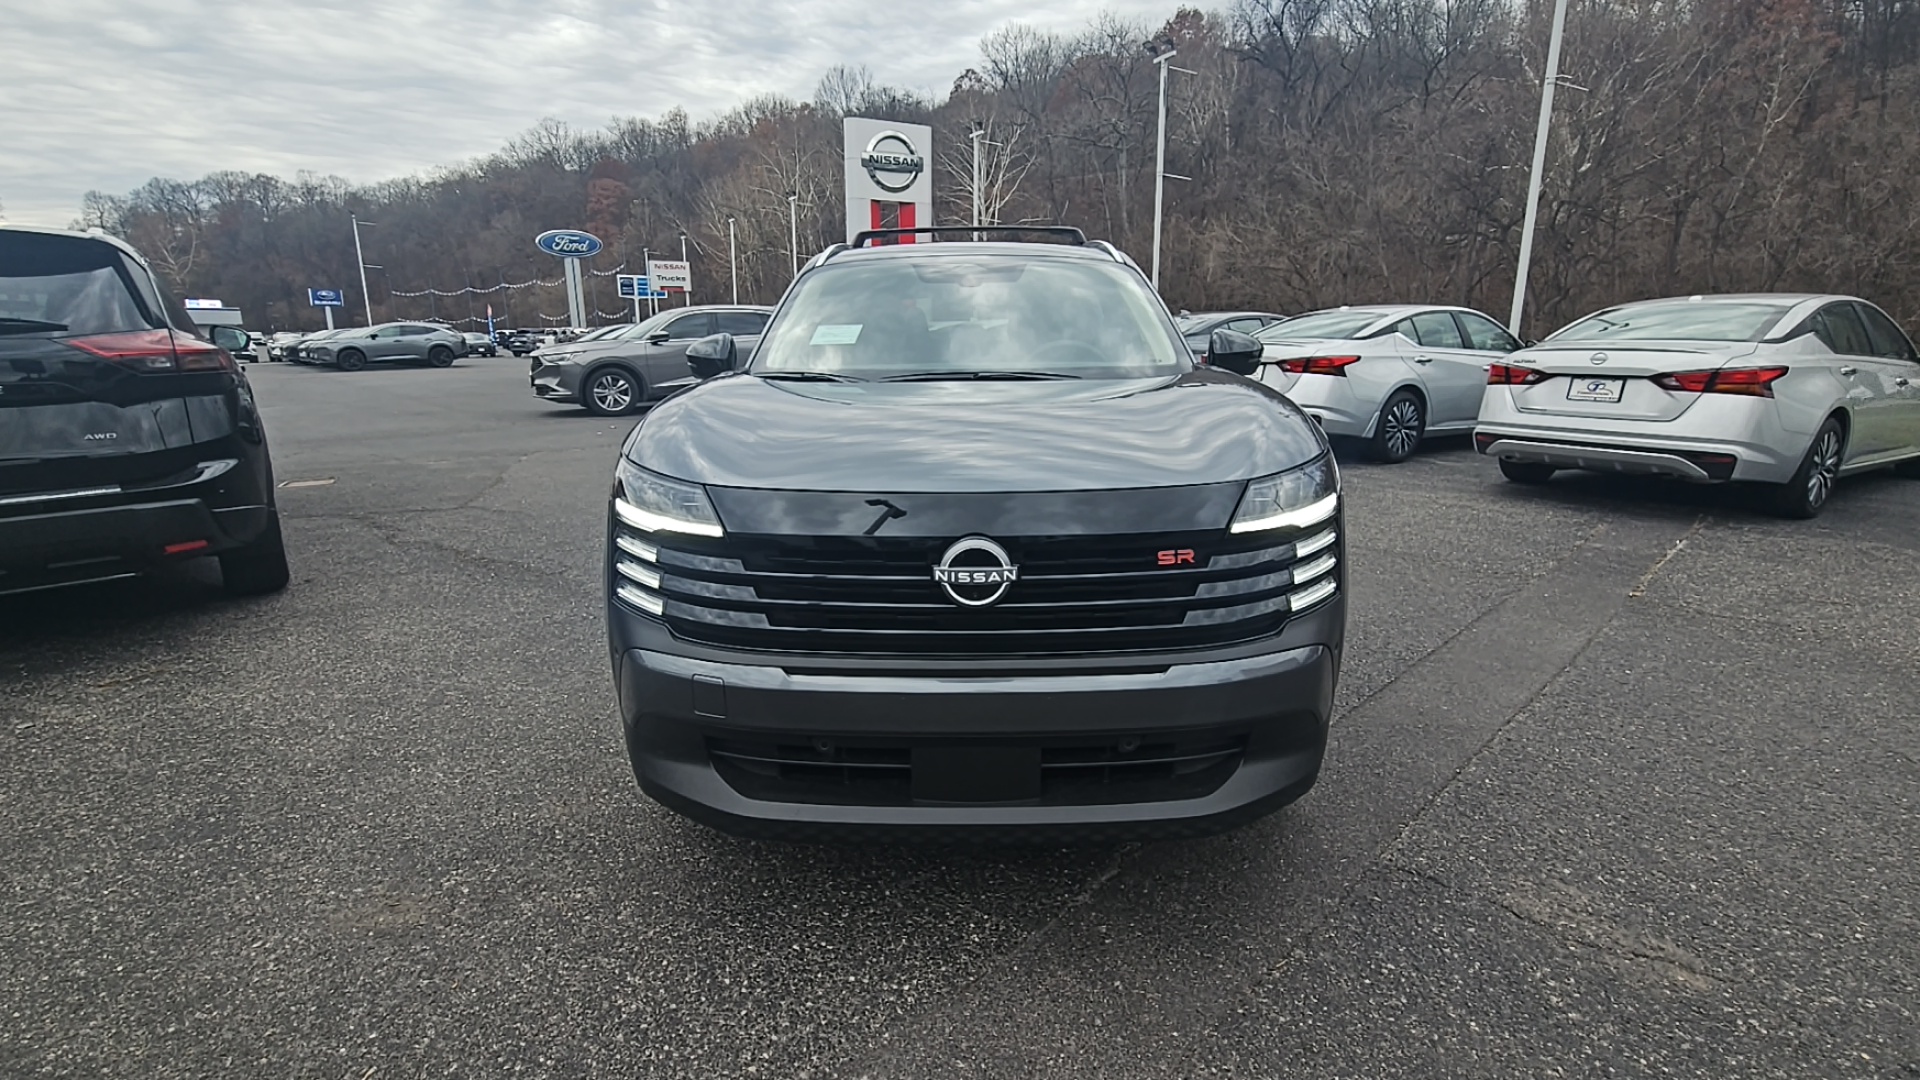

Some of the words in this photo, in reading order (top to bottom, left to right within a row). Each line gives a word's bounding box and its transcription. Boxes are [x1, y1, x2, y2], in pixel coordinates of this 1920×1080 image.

[869, 154, 919, 168] NISSAN
[552, 235, 590, 251] Ford
[84, 432, 117, 440] AWD
[1157, 549, 1195, 565] SR
[935, 570, 1017, 583] NISSAN
